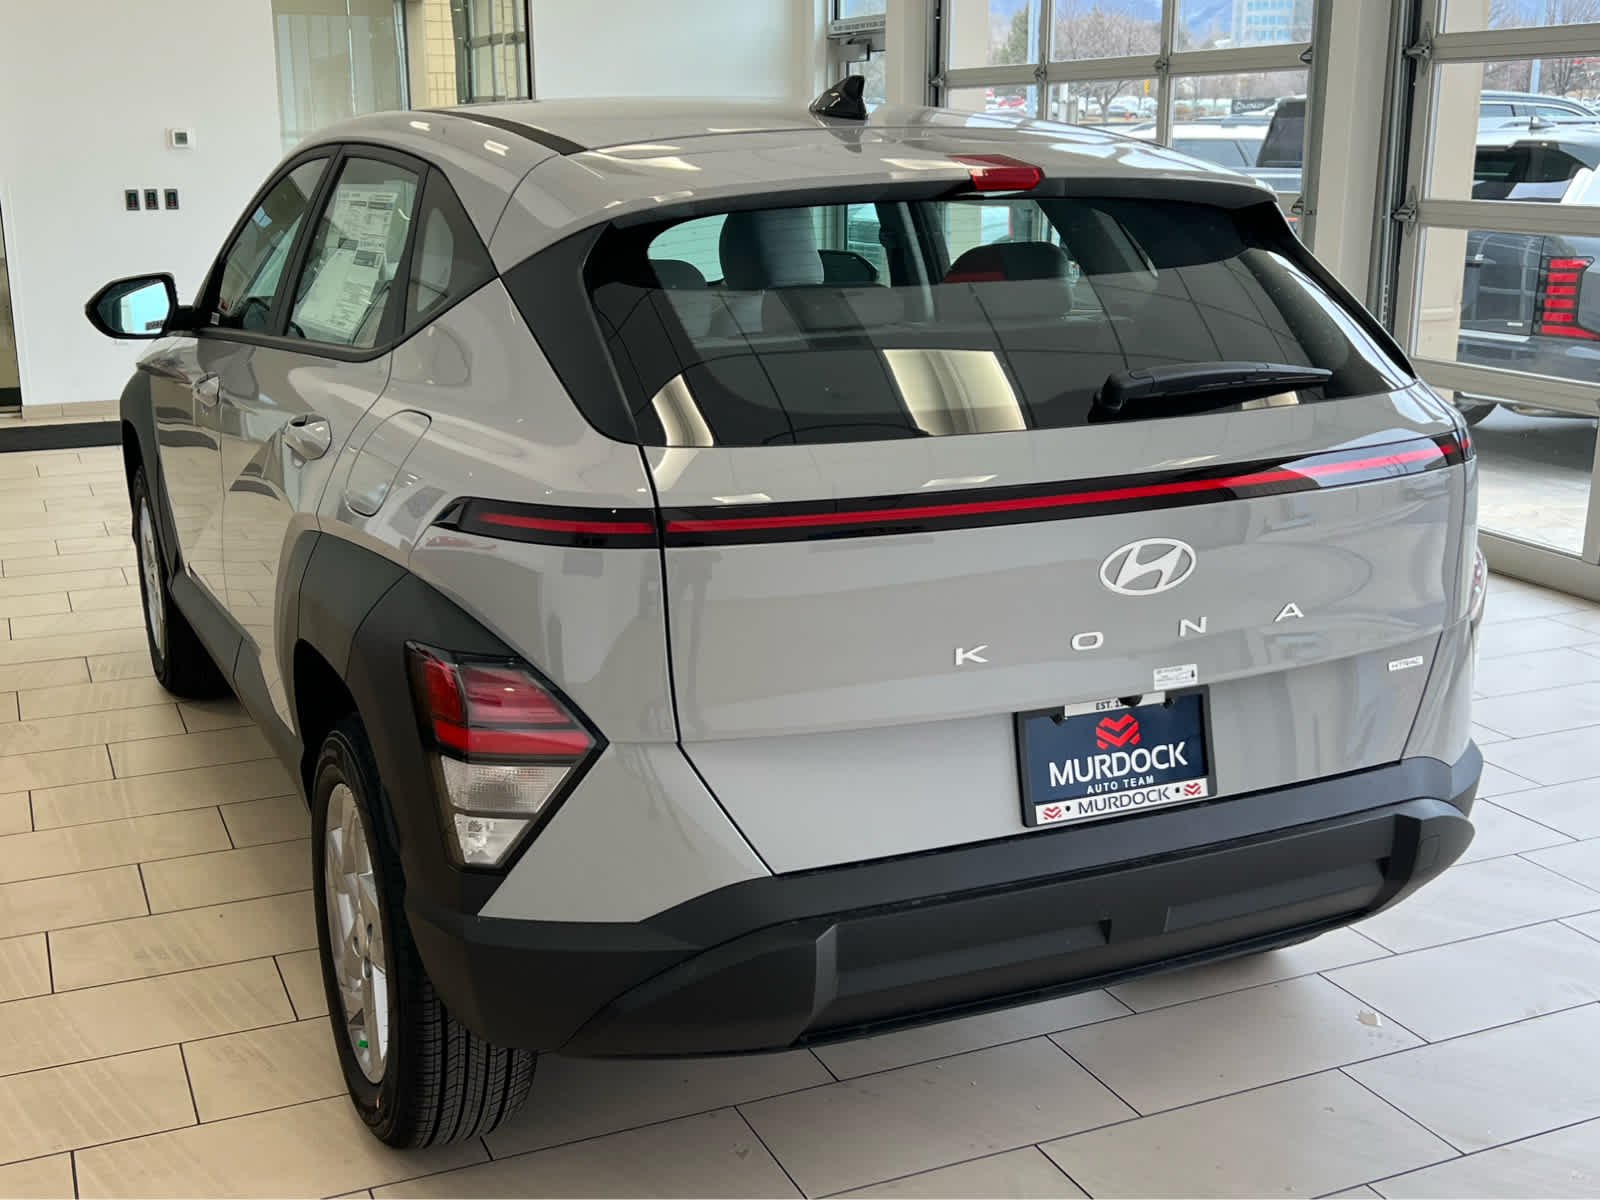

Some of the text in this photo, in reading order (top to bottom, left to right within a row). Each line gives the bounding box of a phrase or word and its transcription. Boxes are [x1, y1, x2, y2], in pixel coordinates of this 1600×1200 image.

[954, 602, 1305, 667] KONA
[1048, 741, 1188, 787] MURDOCK
[1077, 786, 1171, 815] MURDOCK
[1087, 775, 1155, 794] AUTO TEAM
